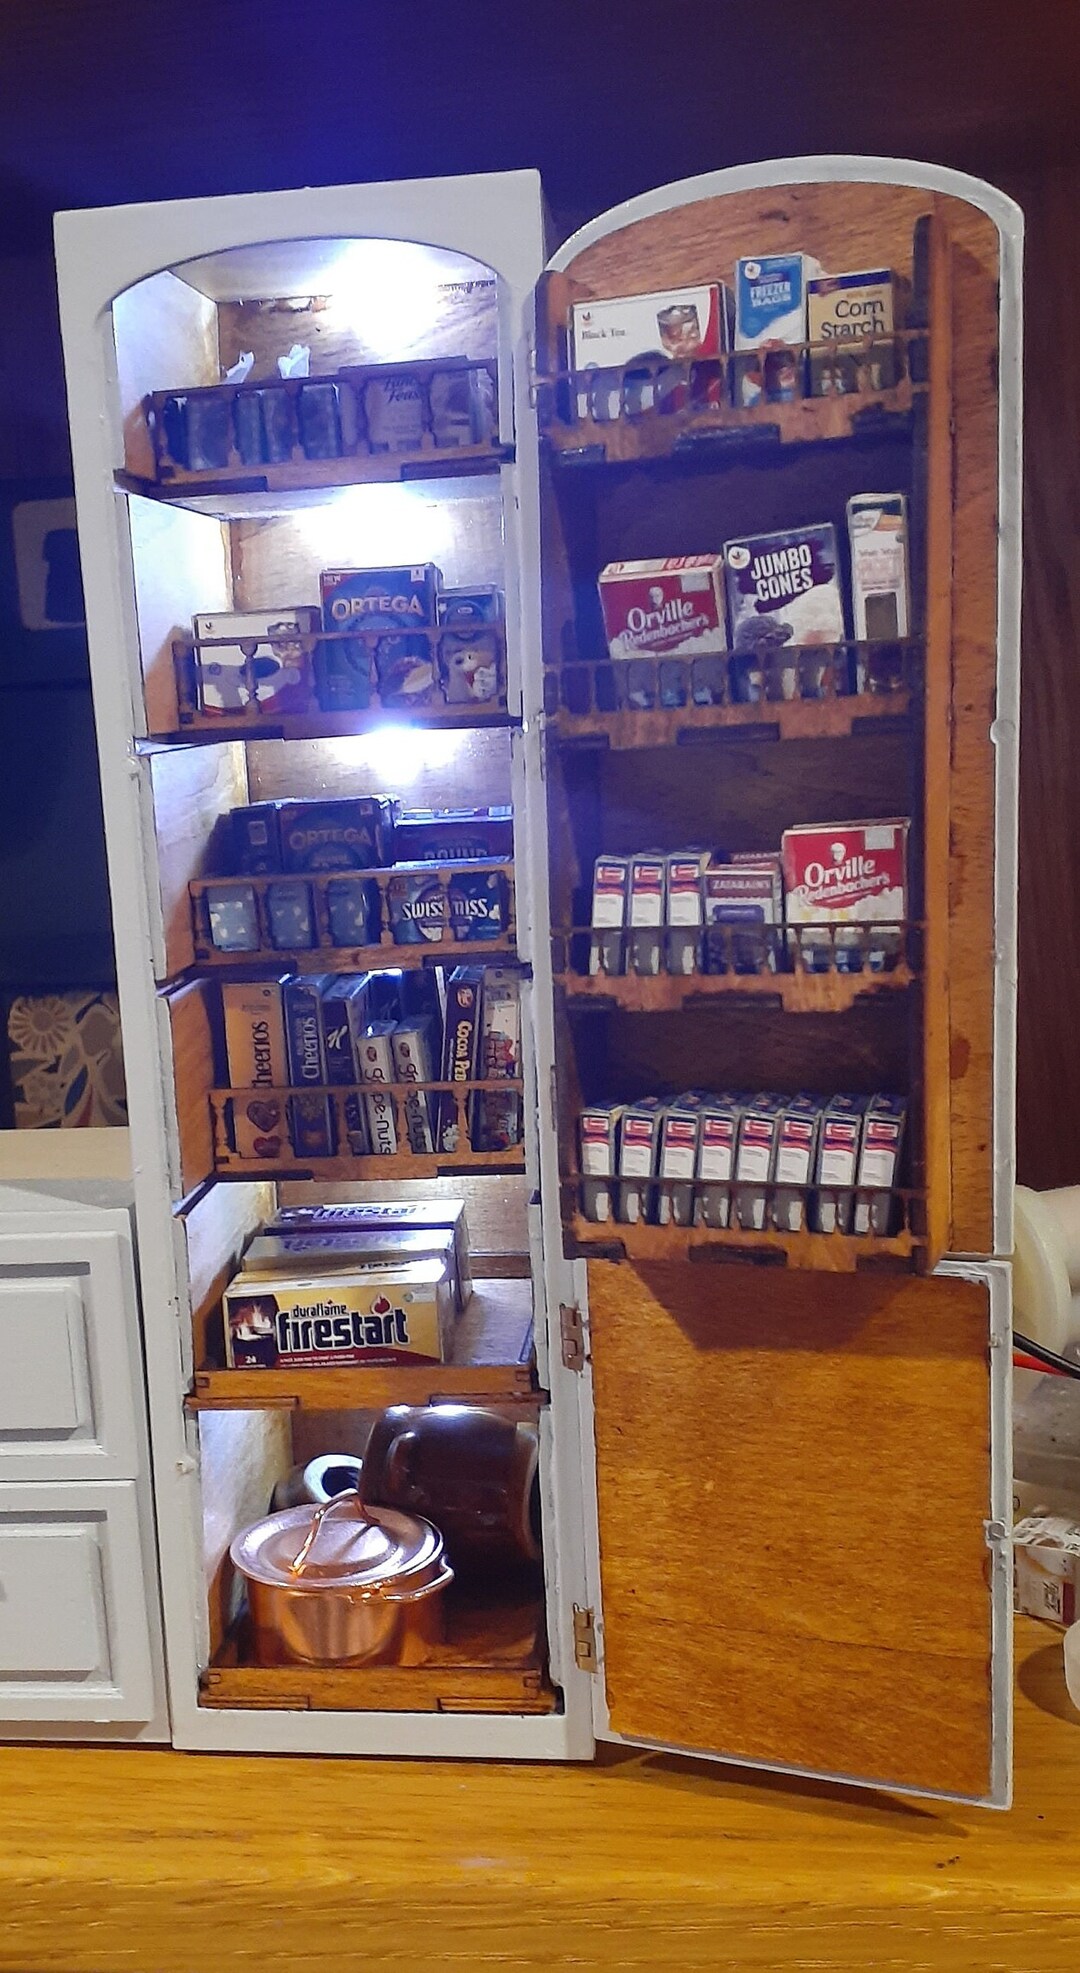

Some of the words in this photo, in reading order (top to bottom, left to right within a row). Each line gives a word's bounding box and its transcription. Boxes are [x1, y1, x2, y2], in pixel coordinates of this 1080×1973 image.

[835, 299, 884, 318] Corn
[821, 316, 885, 339] Starch
[751, 543, 812, 580] JUMBO
[756, 567, 814, 602] CONES
[331, 594, 423, 621] ORTEGA
[627, 598, 694, 631] Orville
[288, 826, 373, 851] ORTEGA
[804, 855, 876, 887] Orville
[250, 1020, 272, 1088] heerios
[302, 1016, 321, 1080] Cheerios
[293, 1303, 347, 1318] duraflame
[279, 1310, 408, 1353] firestart
